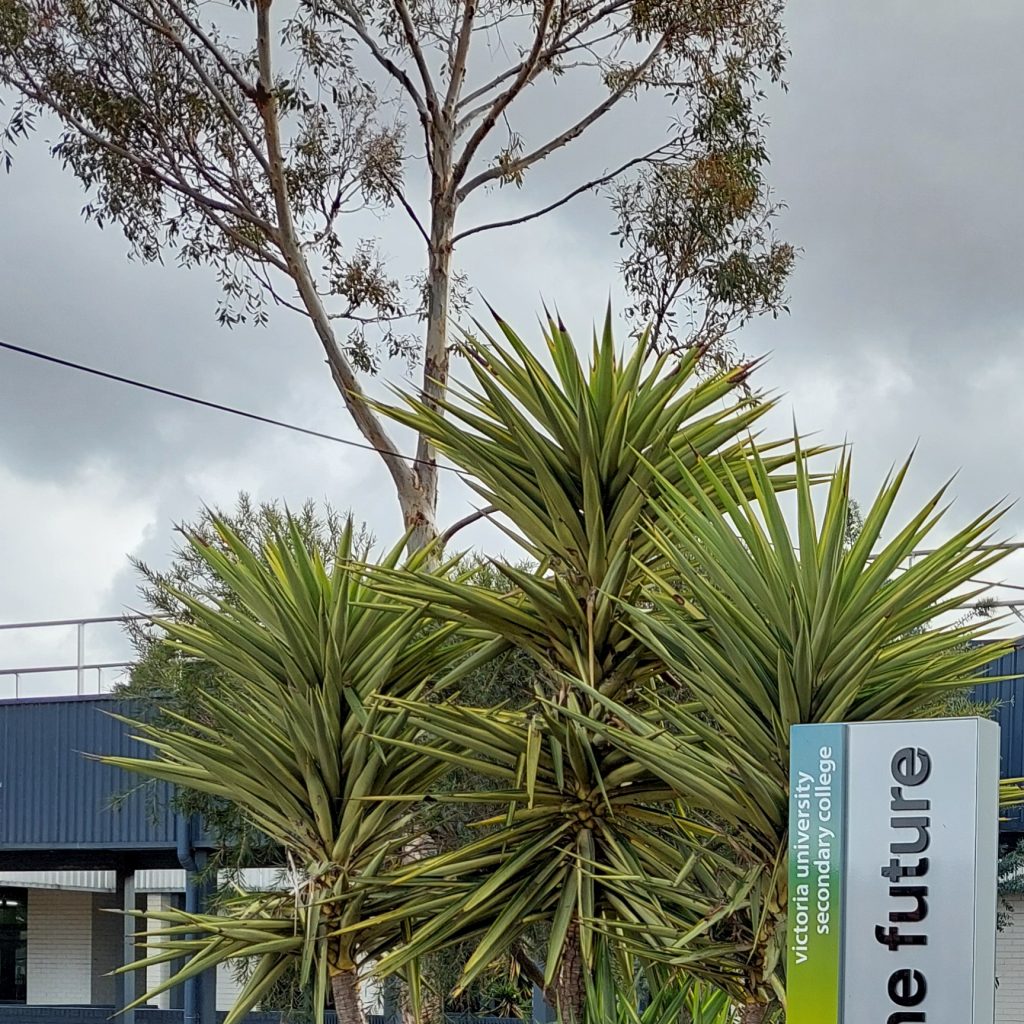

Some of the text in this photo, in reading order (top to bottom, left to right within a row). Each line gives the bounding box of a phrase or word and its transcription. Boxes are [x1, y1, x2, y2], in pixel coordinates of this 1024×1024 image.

[792, 771, 814, 965] victoria university
[813, 746, 836, 935] secondary college
[875, 747, 932, 952] future
